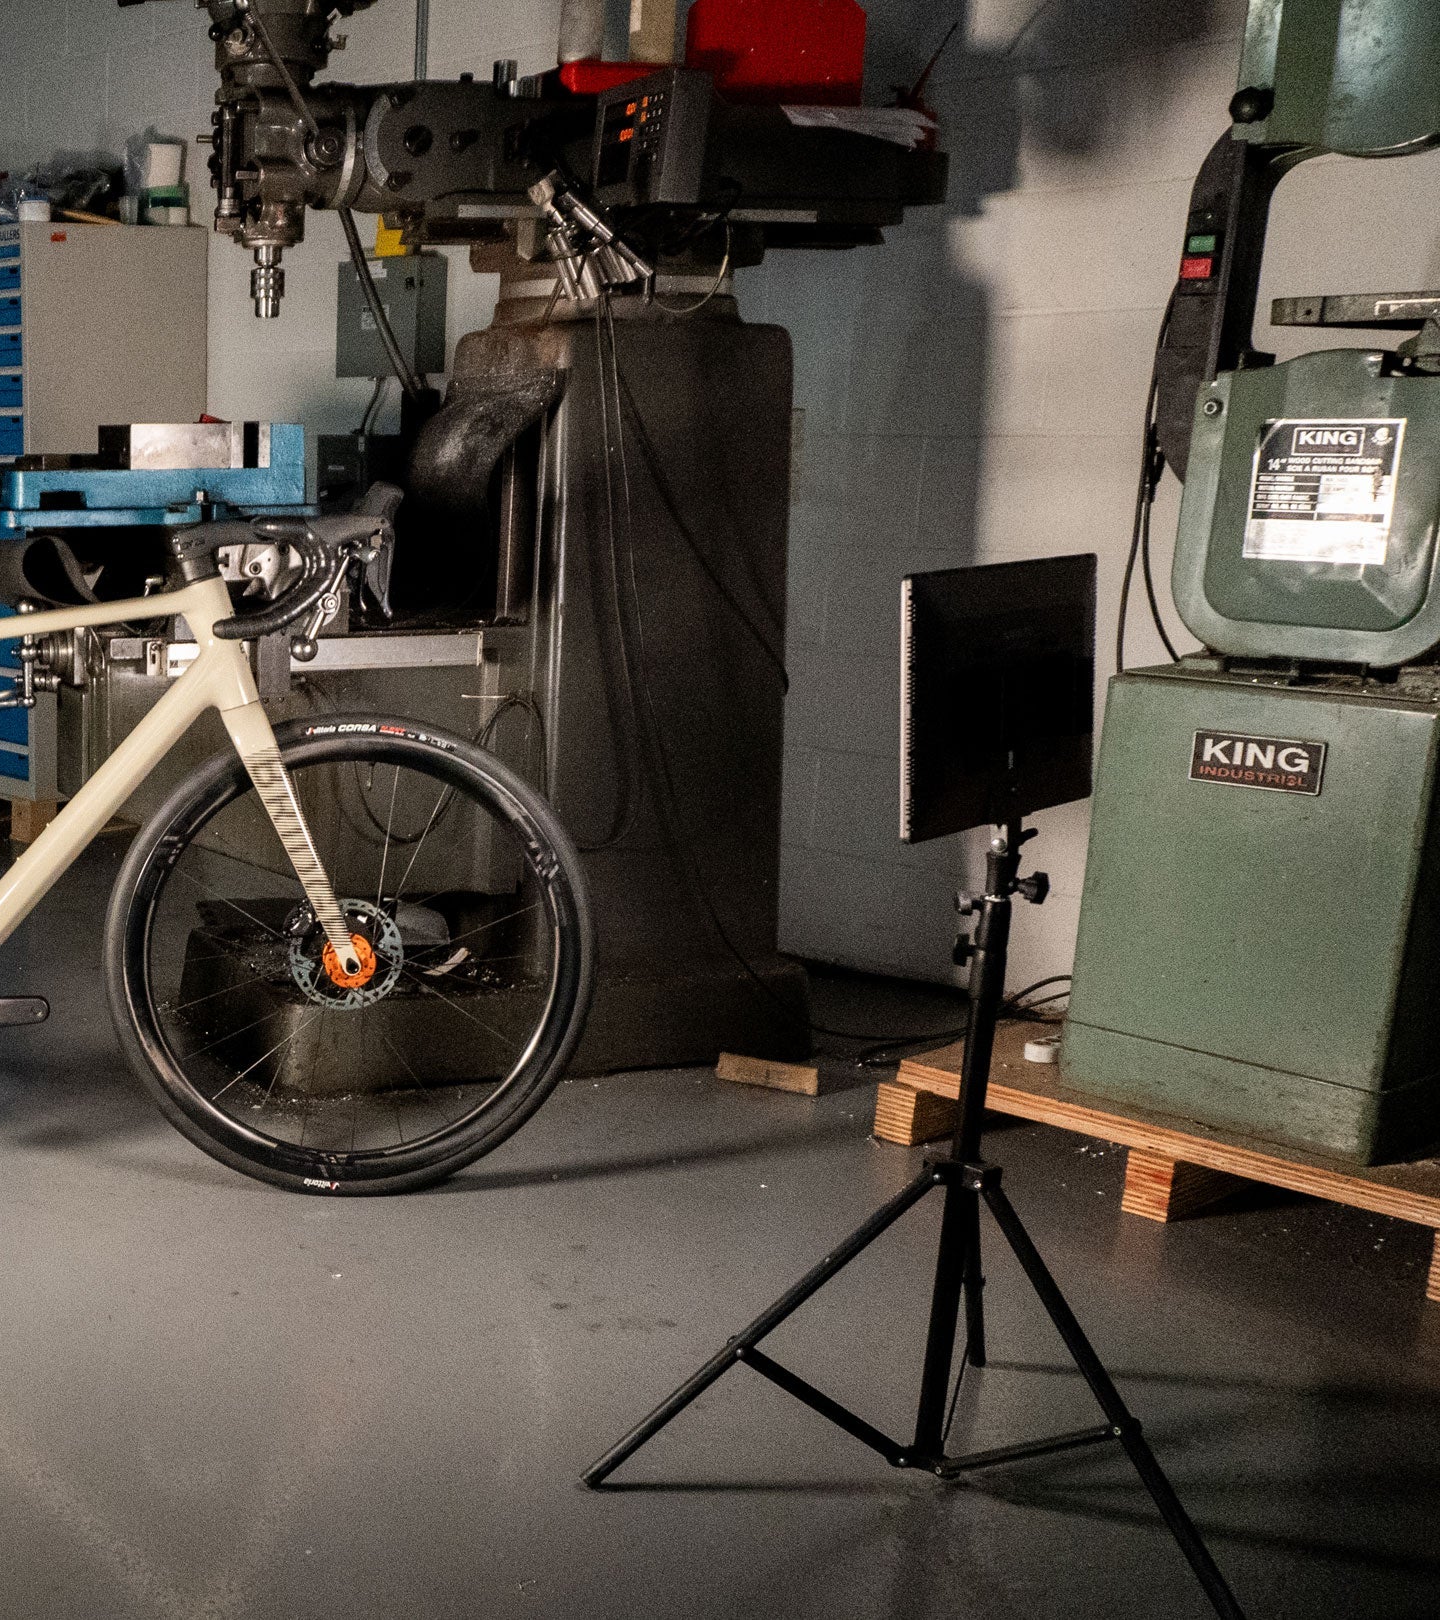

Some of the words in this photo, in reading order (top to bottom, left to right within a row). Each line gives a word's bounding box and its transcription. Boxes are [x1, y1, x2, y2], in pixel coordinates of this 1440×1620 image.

[1299, 431, 1358, 445] KING
[337, 723, 377, 733] CORSA
[1203, 738, 1310, 774] KING
